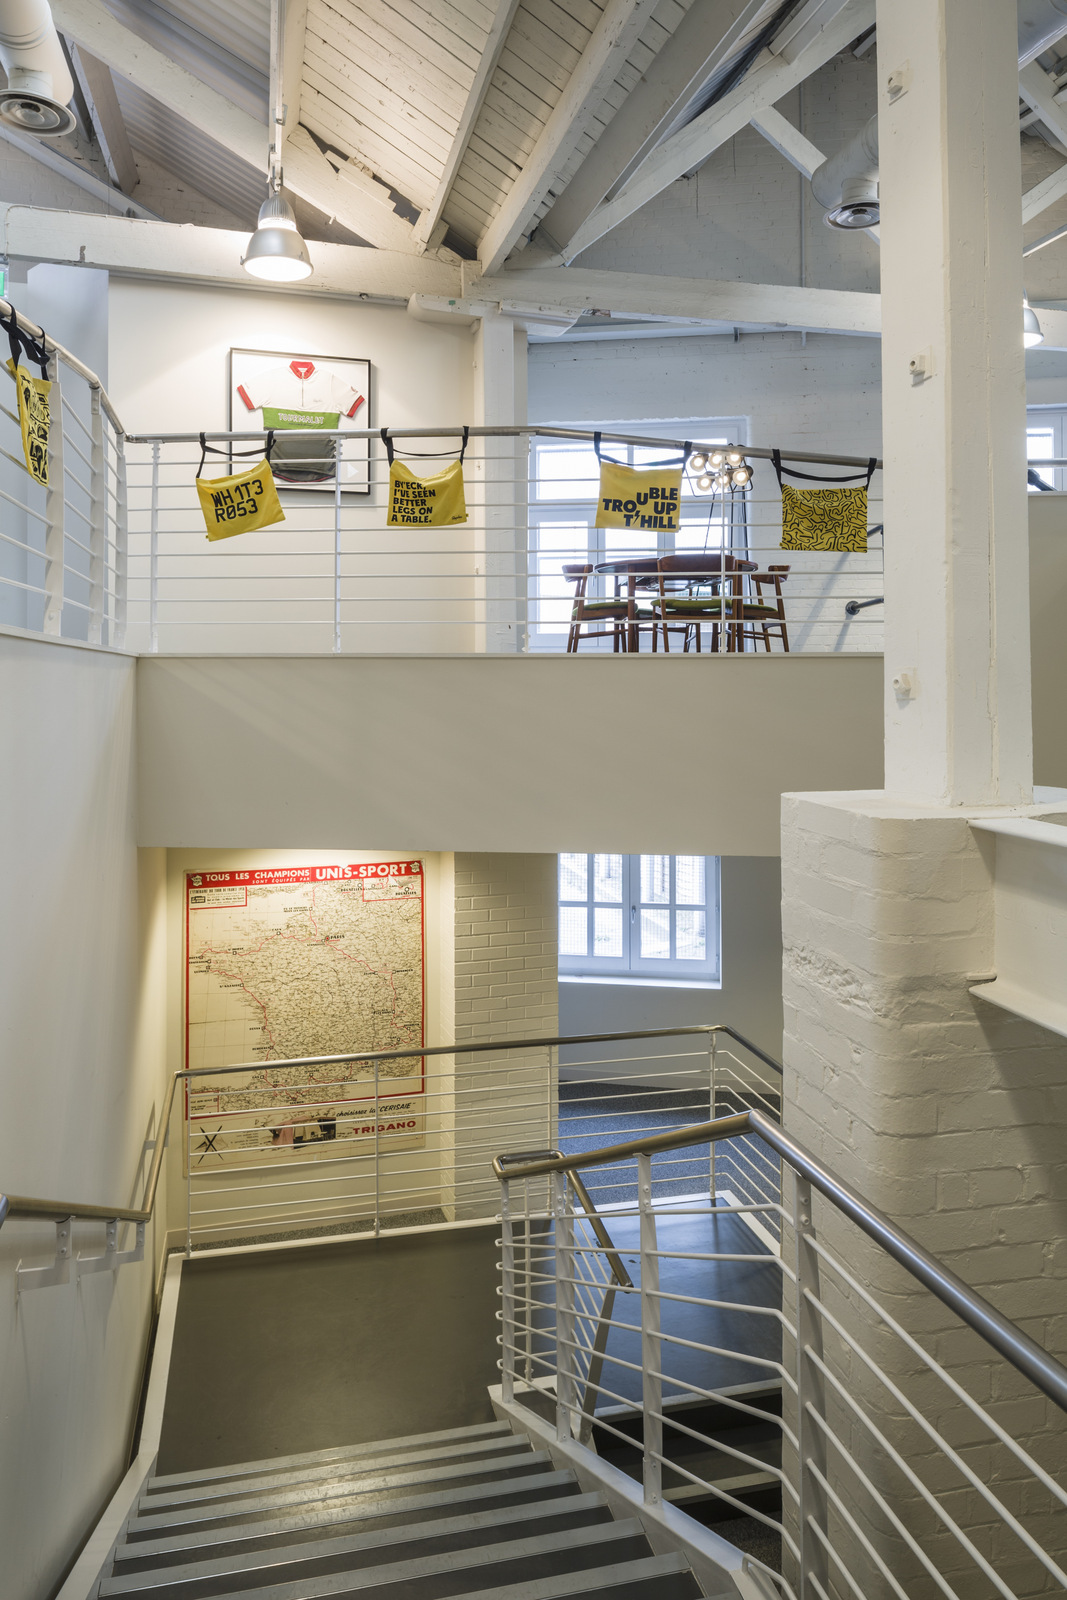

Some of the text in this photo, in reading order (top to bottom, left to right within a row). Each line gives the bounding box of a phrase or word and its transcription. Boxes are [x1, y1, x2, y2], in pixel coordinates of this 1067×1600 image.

[278, 412, 325, 425] TOURMALET
[394, 488, 436, 498] I'VE SEEN
[393, 497, 427, 507] BETTER
[653, 501, 678, 515] UP
[392, 506, 433, 515] LEGS ON
[391, 514, 432, 523] A TABLE.
[205, 873, 230, 882] TOUS
[235, 872, 250, 880] LES
[254, 869, 310, 879] CHAMPIONS
[315, 863, 407, 880] UNIS-SPORT
[352, 1120, 416, 1135] TRIGANO
